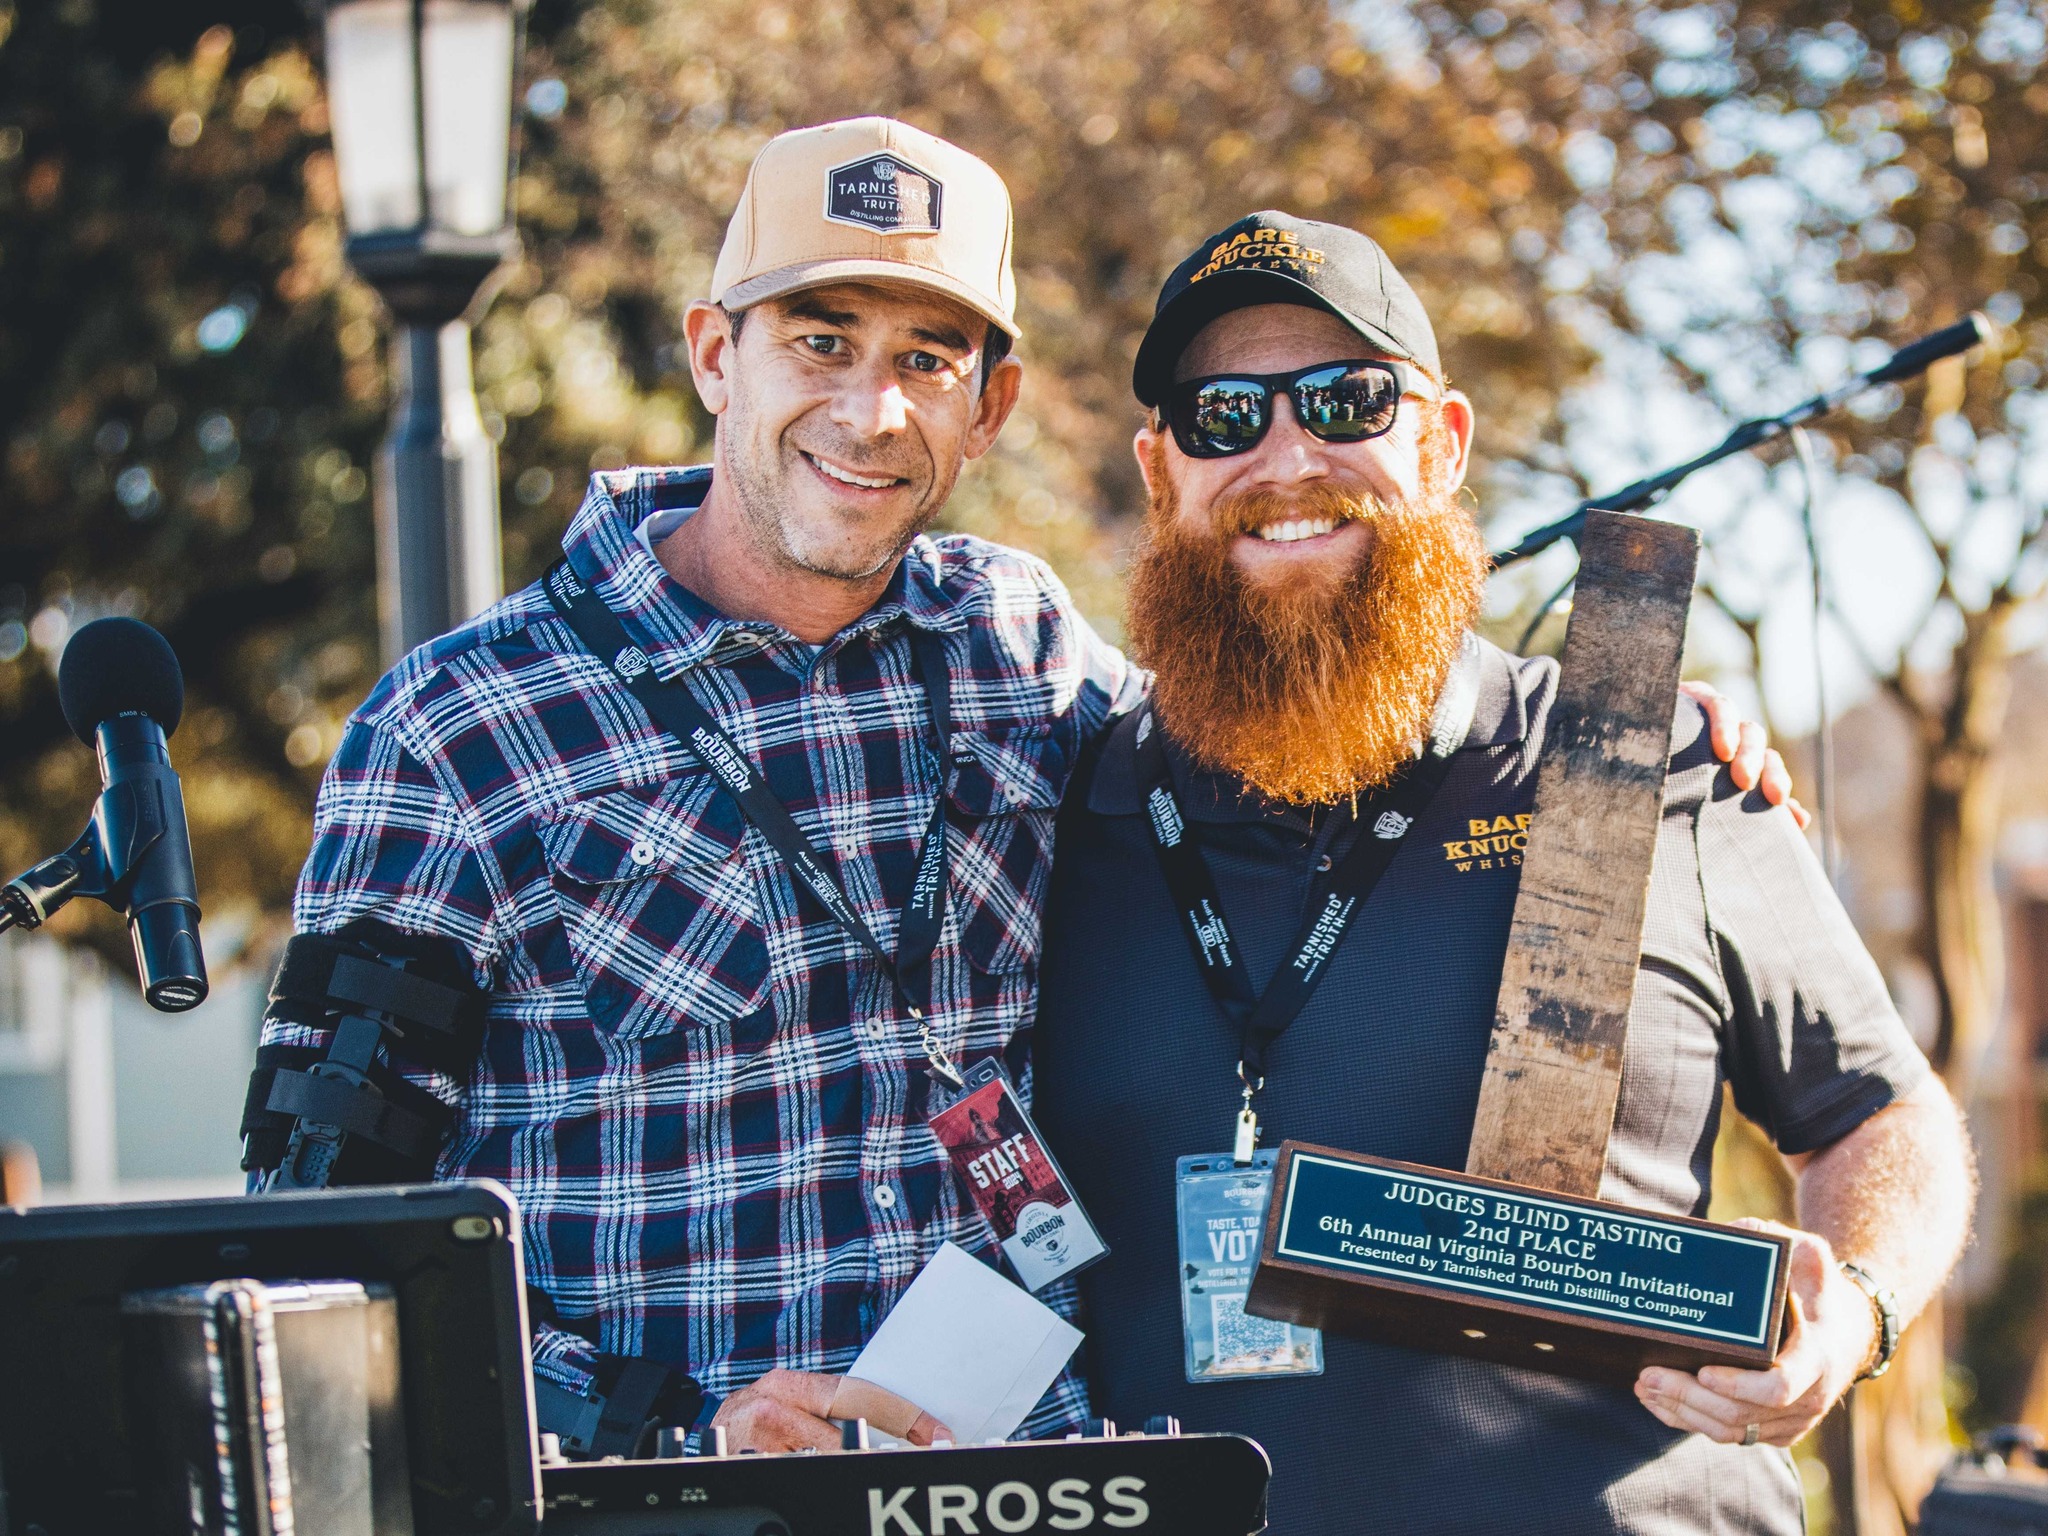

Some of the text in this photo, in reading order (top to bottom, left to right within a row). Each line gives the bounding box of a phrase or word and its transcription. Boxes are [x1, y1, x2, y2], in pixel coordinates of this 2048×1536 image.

[838, 182, 931, 204] TARNISHED
[863, 200, 903, 212] TRUTH
[850, 210, 884, 222] DISTILLING
[1190, 243, 1325, 284] KNUCKLE
[1210, 229, 1298, 261] BARE
[691, 726, 752, 793] BOURBON
[694, 741, 735, 788] INVITATIONAL
[955, 755, 976, 763] RVCA
[1147, 802, 1166, 844] INVITATIONAL
[1149, 787, 1182, 848] BOURBON
[911, 836, 938, 909] TARNISHED
[925, 848, 943, 892] TRUTH
[1455, 855, 1521, 872] WHIS
[798, 851, 856, 924] Audi Virginia Beach
[1200, 899, 1233, 967] Audi Virginia Beach
[1293, 899, 1342, 969] TARNISHED
[1313, 916, 1346, 961] TRUTH
[1340, 896, 1356, 919] COMPANY
[967, 1132, 1031, 1190] STAFF
[1003, 1170, 1024, 1190] 2024
[1224, 1187, 1266, 1198] BOURBON
[1020, 1215, 1065, 1247] BOURBON
[1207, 1218, 1241, 1230] TASTE,
[1384, 1182, 1683, 1254] JUDGES BLIND TASTING
[1208, 1229, 1259, 1263] VOT
[1463, 1220, 1597, 1261] 2nd PLACE
[1207, 1268, 1224, 1277] VOTE
[1225, 1267, 1238, 1276] FOR
[1319, 1216, 1734, 1308] 6th Annual Virginia Bourbon Invitational
[1340, 1240, 1707, 1322] Presented by Tarnished Truth Distilling Company
[867, 1476, 1151, 1536] KROSS
